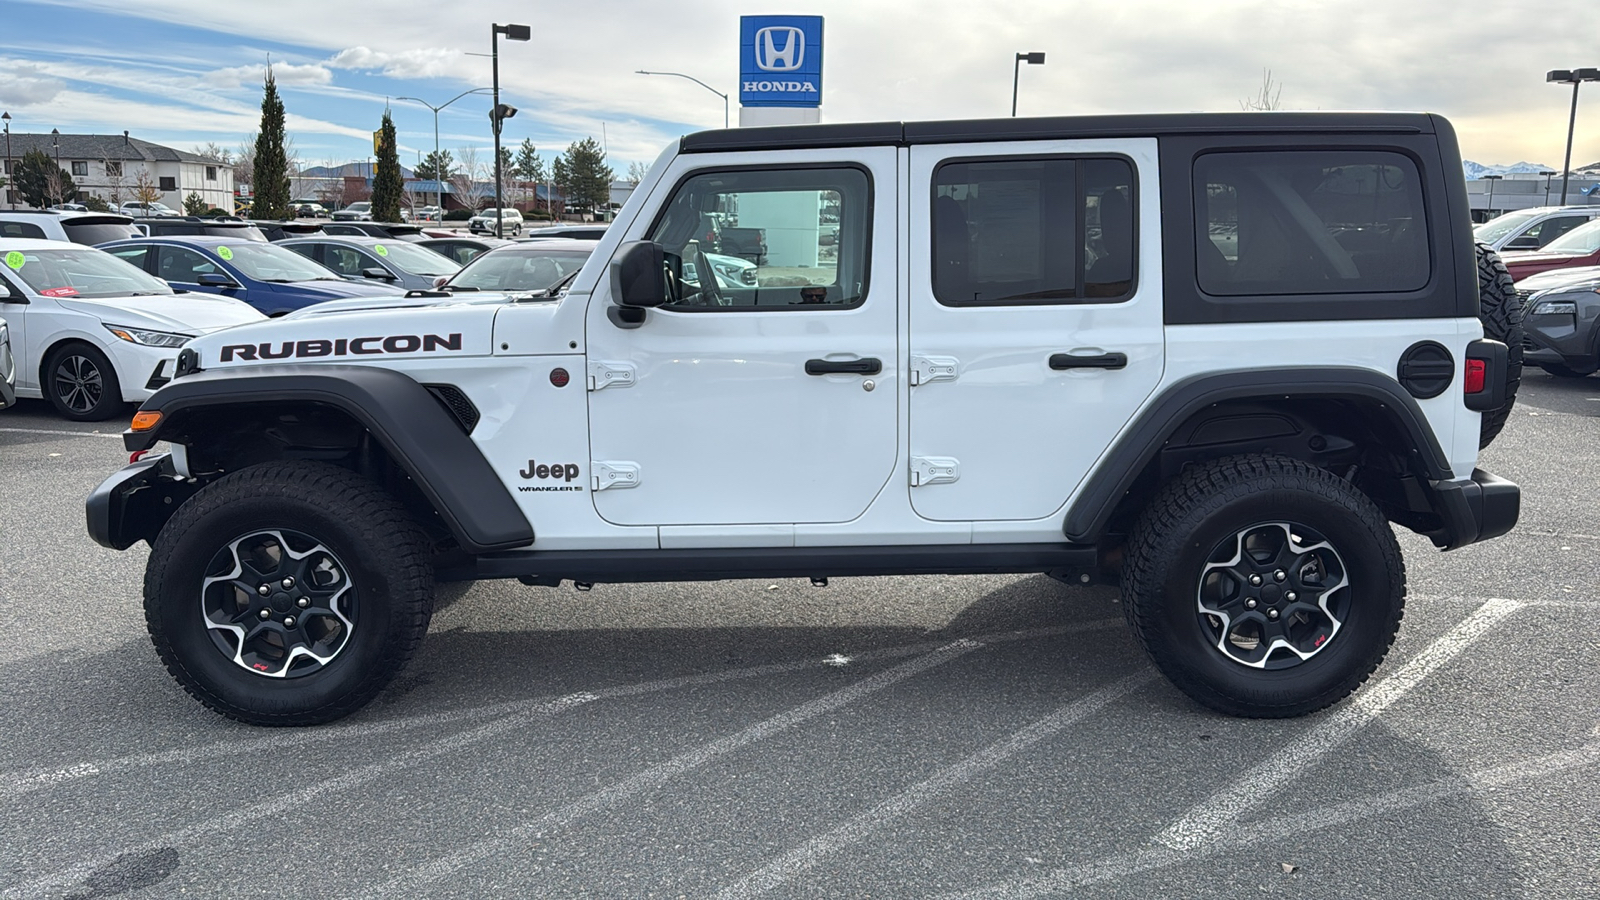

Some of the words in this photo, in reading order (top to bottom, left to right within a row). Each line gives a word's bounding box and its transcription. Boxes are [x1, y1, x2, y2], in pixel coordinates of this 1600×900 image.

[742, 81, 817, 92] HONDA
[220, 333, 462, 362] RUBICON
[519, 460, 579, 482] Jeep
